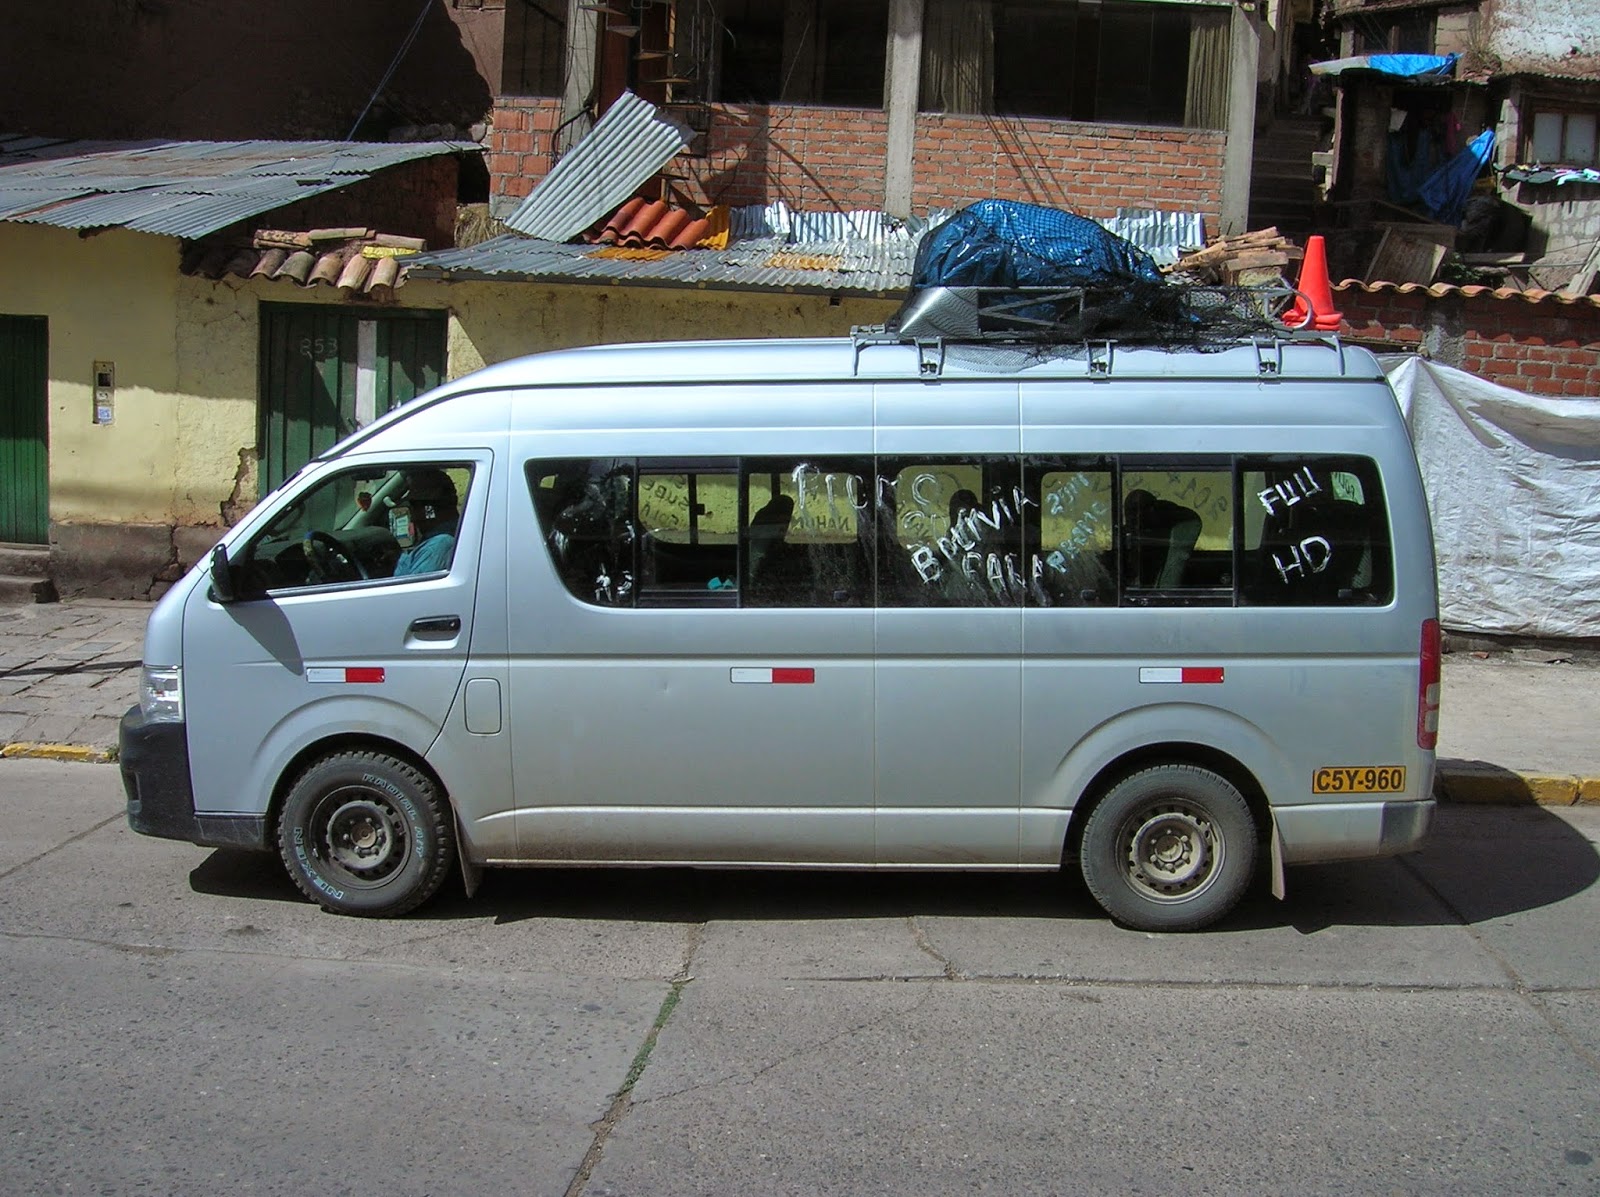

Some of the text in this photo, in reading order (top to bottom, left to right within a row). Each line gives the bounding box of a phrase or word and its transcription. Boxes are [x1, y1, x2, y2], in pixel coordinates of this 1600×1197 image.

[1272, 536, 1332, 584] HD
[1317, 769, 1403, 791] C5Y-960
[294, 827, 344, 900] NEXEN
